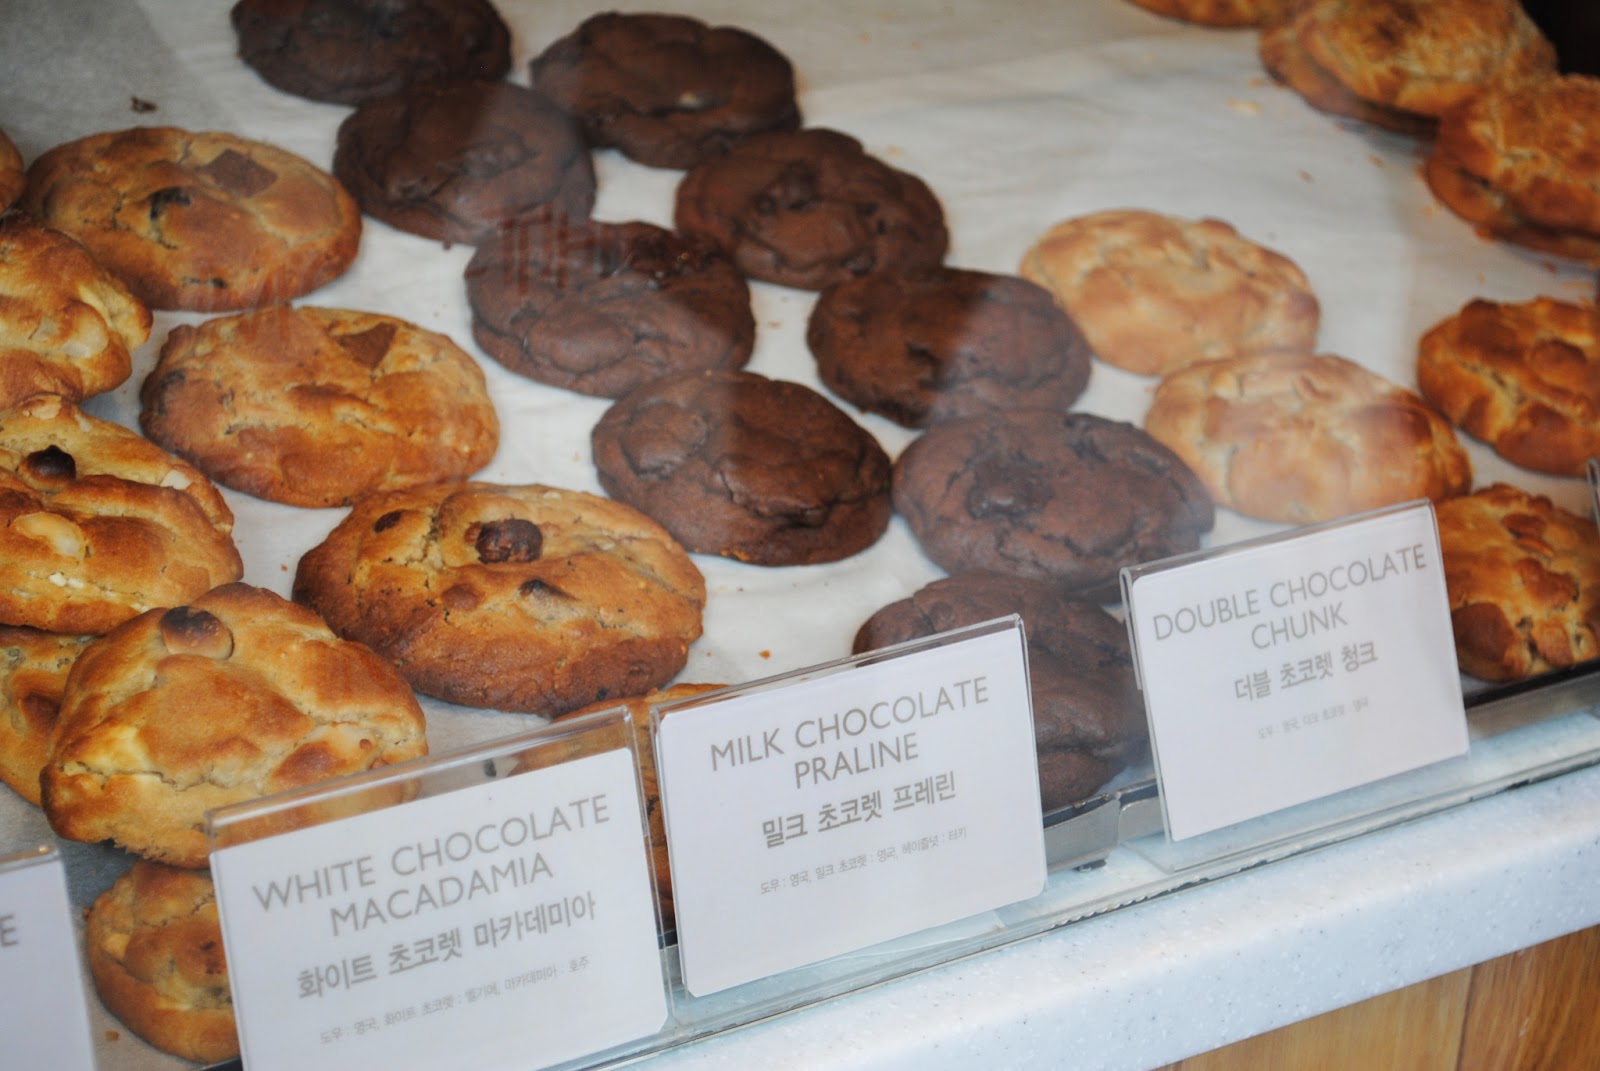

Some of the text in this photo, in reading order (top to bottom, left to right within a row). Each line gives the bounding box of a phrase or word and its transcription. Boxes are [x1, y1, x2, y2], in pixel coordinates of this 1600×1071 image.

[1152, 543, 1428, 641] DOUBLE CHOCOLATE
[1250, 601, 1348, 650] CHUNK
[1233, 641, 1378, 702] 더블 초코렛 청크
[710, 676, 989, 771] MILK CHOCOLATE
[794, 732, 919, 789] PRALINE
[762, 771, 956, 849] 밀크 초코렛 프레린
[252, 794, 610, 912] WHITE CHOCOLATE
[331, 852, 553, 937] MACADAMIA
[297, 891, 596, 999] 화이트 초코렛 마카데미아
